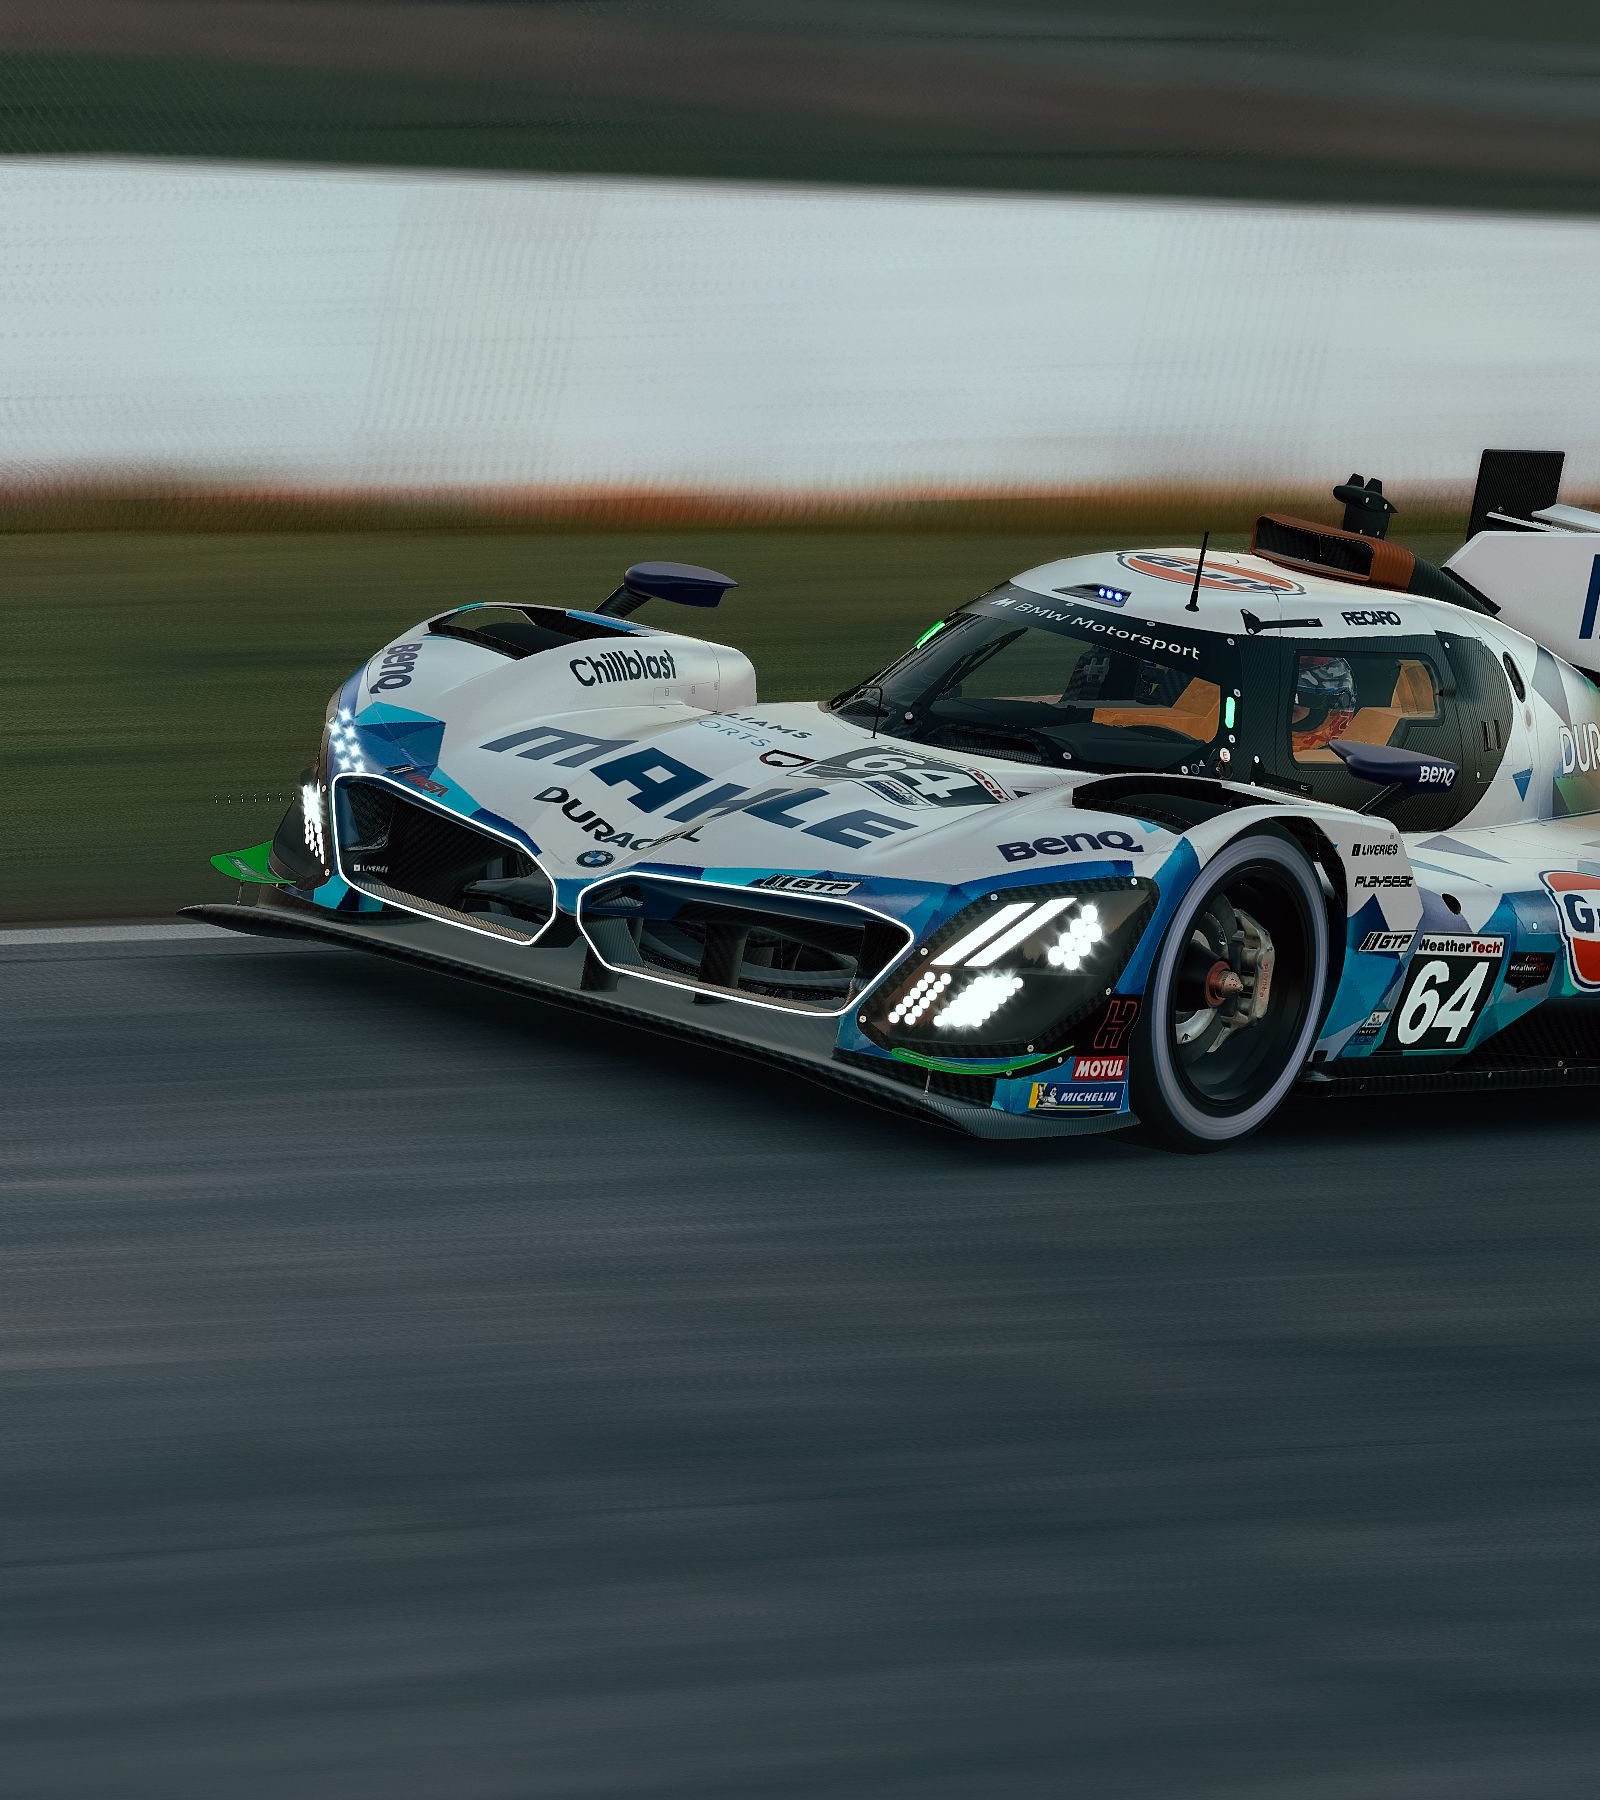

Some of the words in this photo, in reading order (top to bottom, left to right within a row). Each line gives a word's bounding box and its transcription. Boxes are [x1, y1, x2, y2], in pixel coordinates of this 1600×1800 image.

[1135, 554, 1292, 592] Gulf
[1014, 602, 1071, 622] BMW
[1070, 616, 1202, 661] Motorsport
[1341, 610, 1402, 626] RECARO
[369, 643, 423, 694] BenQ
[569, 649, 678, 687] Chillblast
[478, 725, 919, 850] MAHLE
[846, 752, 978, 799] 64
[1418, 765, 1456, 787] BenQ
[532, 786, 705, 852] DURACL
[996, 830, 1145, 863] BenQ
[1361, 843, 1399, 856] LIVERIES
[788, 877, 854, 893] GTP
[1377, 934, 1413, 949] GTP
[1418, 938, 1503, 955] WeatherTech
[1397, 960, 1490, 1045] 64
[1074, 1059, 1124, 1077] MOTUL
[1060, 1091, 1117, 1102] MICHELIN
